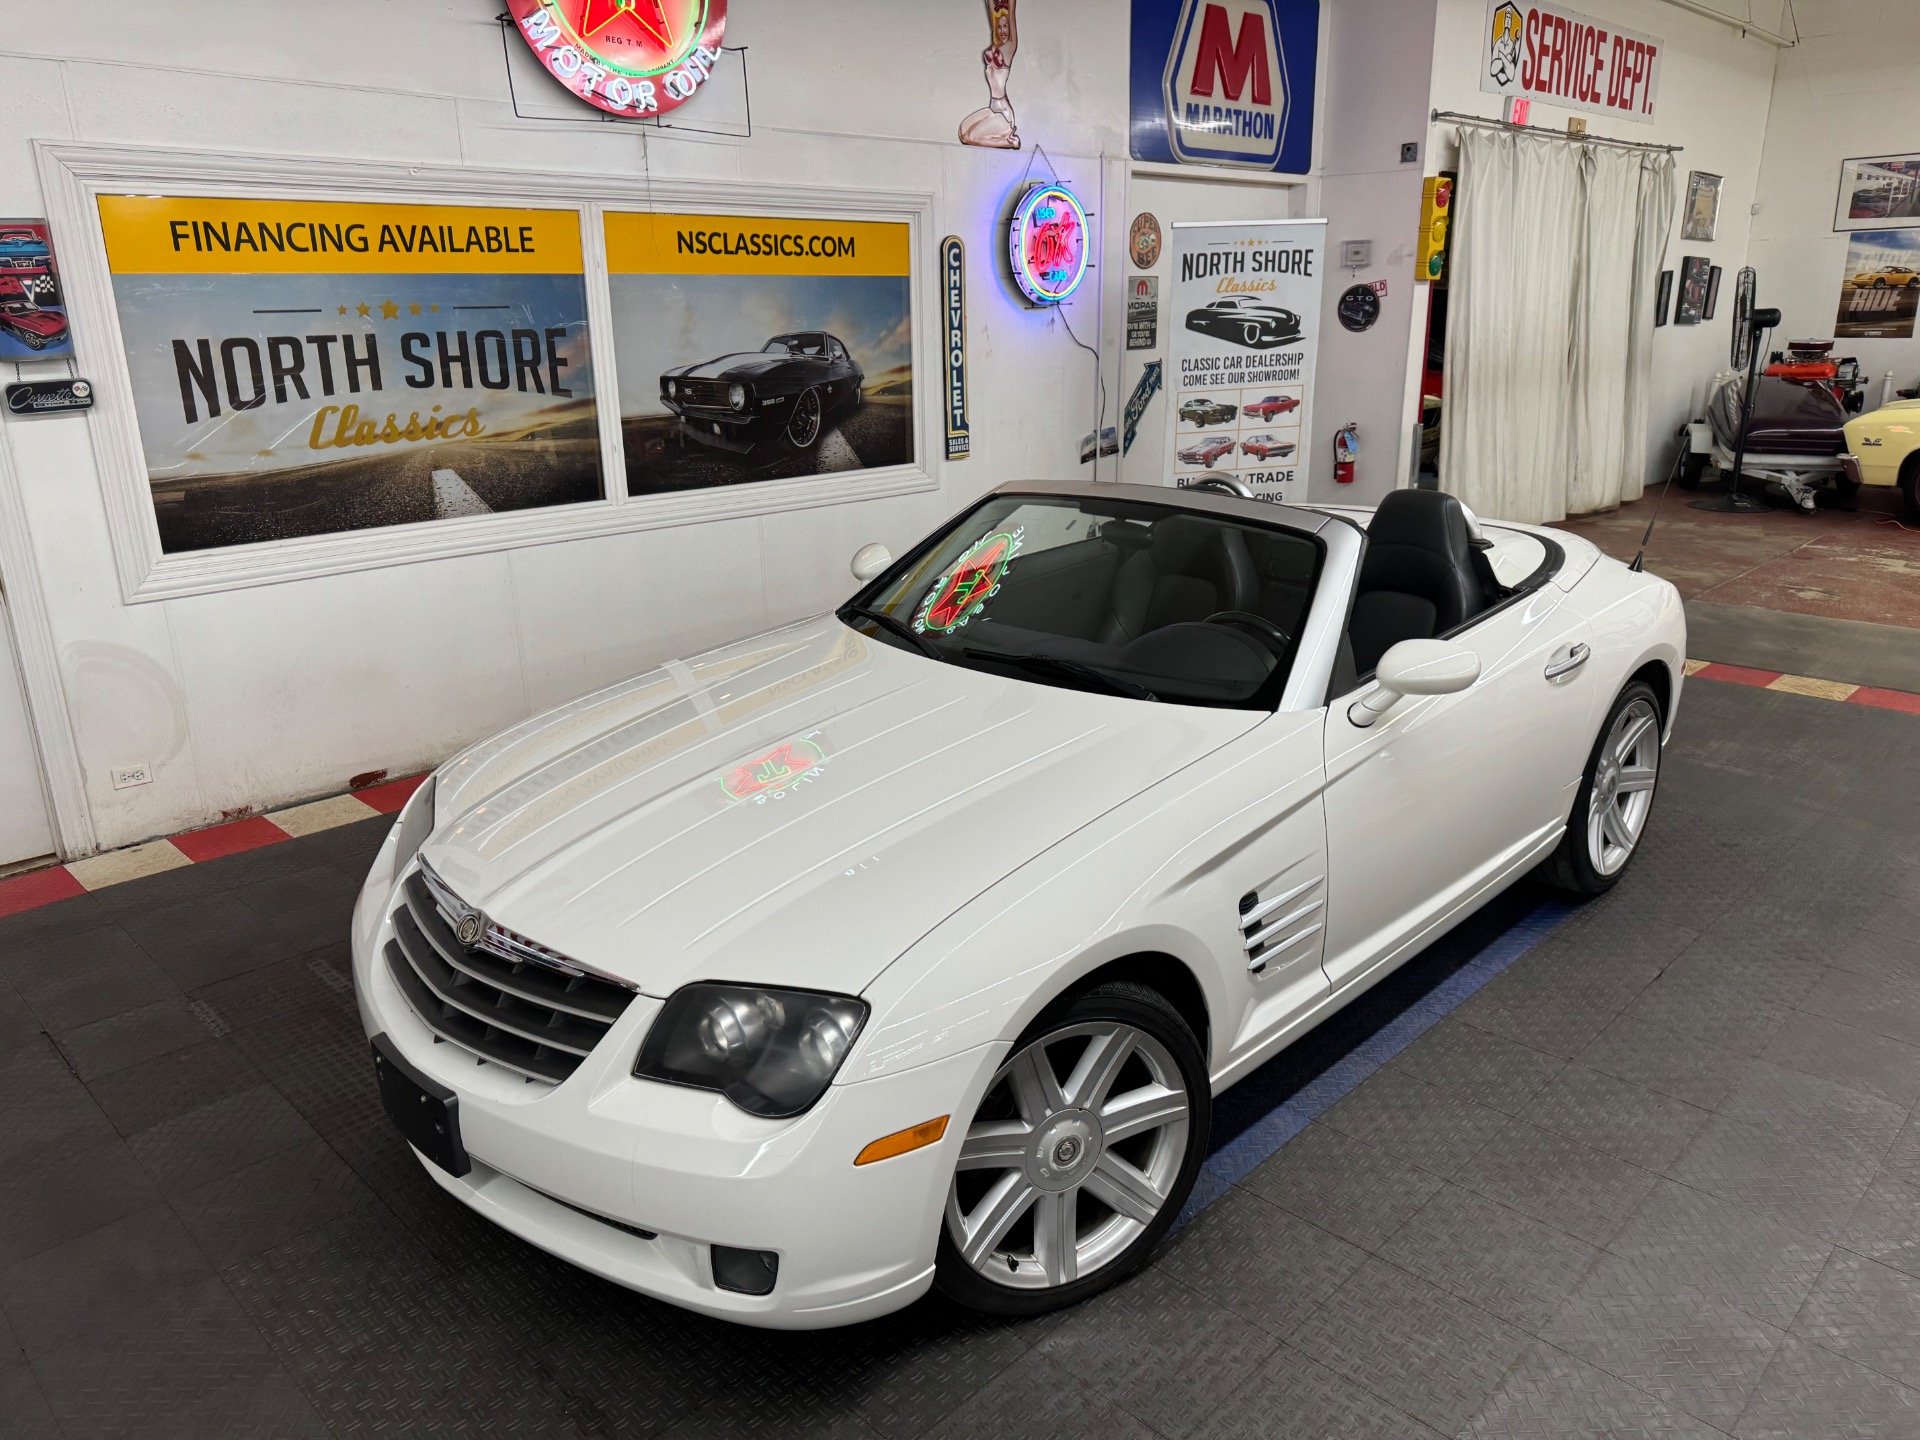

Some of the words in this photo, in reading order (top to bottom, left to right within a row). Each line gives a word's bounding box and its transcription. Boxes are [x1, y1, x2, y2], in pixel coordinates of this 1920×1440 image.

[522, 9, 657, 112] MOTOR
[664, 45, 722, 100] OIL
[1190, 3, 1271, 106] M
[1521, 8, 1607, 104] SERVICE
[1607, 35, 1657, 115] DEPT.
[1185, 102, 1274, 140] MARATHON
[1513, 98, 1530, 125] EXIT
[1035, 207, 1056, 219] USED
[170, 220, 369, 253] FINANCING
[377, 224, 535, 254] AVAILABLE
[677, 230, 856, 258] NSCLASSICS.COM
[1034, 211, 1076, 273] OK
[1181, 251, 1245, 282] NORTH
[1251, 249, 1314, 277] SHORE
[1216, 276, 1277, 294] Classics
[1848, 288, 1902, 312] RIDE
[949, 247, 964, 427] CHEVROLET
[172, 333, 383, 425] NORTH
[401, 327, 573, 399] SHORE
[1181, 358, 1220, 372] CLASSIC
[1223, 355, 1242, 370] CAR
[1245, 352, 1304, 369] DEALERSHIP
[1183, 375, 1207, 387] COME
[1209, 373, 1225, 385] SEE
[1228, 371, 1245, 384] OUR
[1247, 369, 1300, 383] SHOWROOM!
[10, 387, 75, 409] Corvette
[1131, 381, 1152, 420] Ford
[308, 403, 486, 451] Classics
[949, 438, 964, 446] SALES
